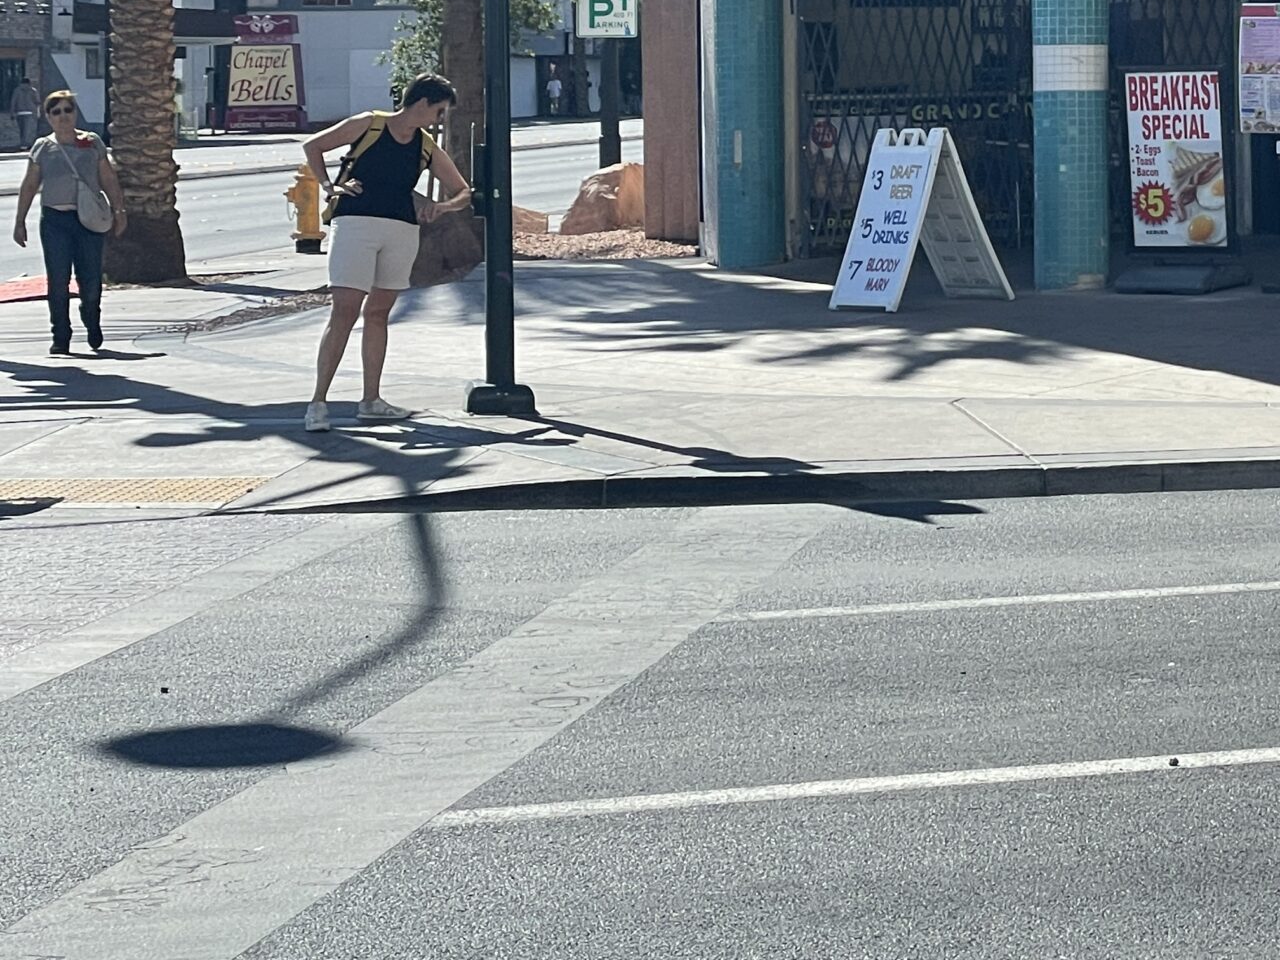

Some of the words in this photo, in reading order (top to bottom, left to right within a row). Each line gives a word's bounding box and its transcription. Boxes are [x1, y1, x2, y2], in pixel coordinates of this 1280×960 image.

[233, 48, 291, 74] Chapel
[231, 75, 294, 102] Bells
[1128, 74, 1219, 112] BREAKFAST
[1141, 113, 1210, 141] SPECIAL
[1136, 156, 1156, 166] Toast
[1144, 144, 1161, 156] Eggs
[872, 170, 884, 190] $3
[890, 165, 923, 179] DRAFT
[1136, 167, 1160, 177] Bacon
[889, 185, 913, 199] BEER
[1139, 188, 1165, 218] $5
[883, 210, 907, 225] WELL
[860, 218, 874, 239] $5
[872, 230, 910, 244] DRINKS
[849, 260, 863, 280] $7
[866, 258, 900, 273] BLOODY
[864, 278, 889, 291] MARY
